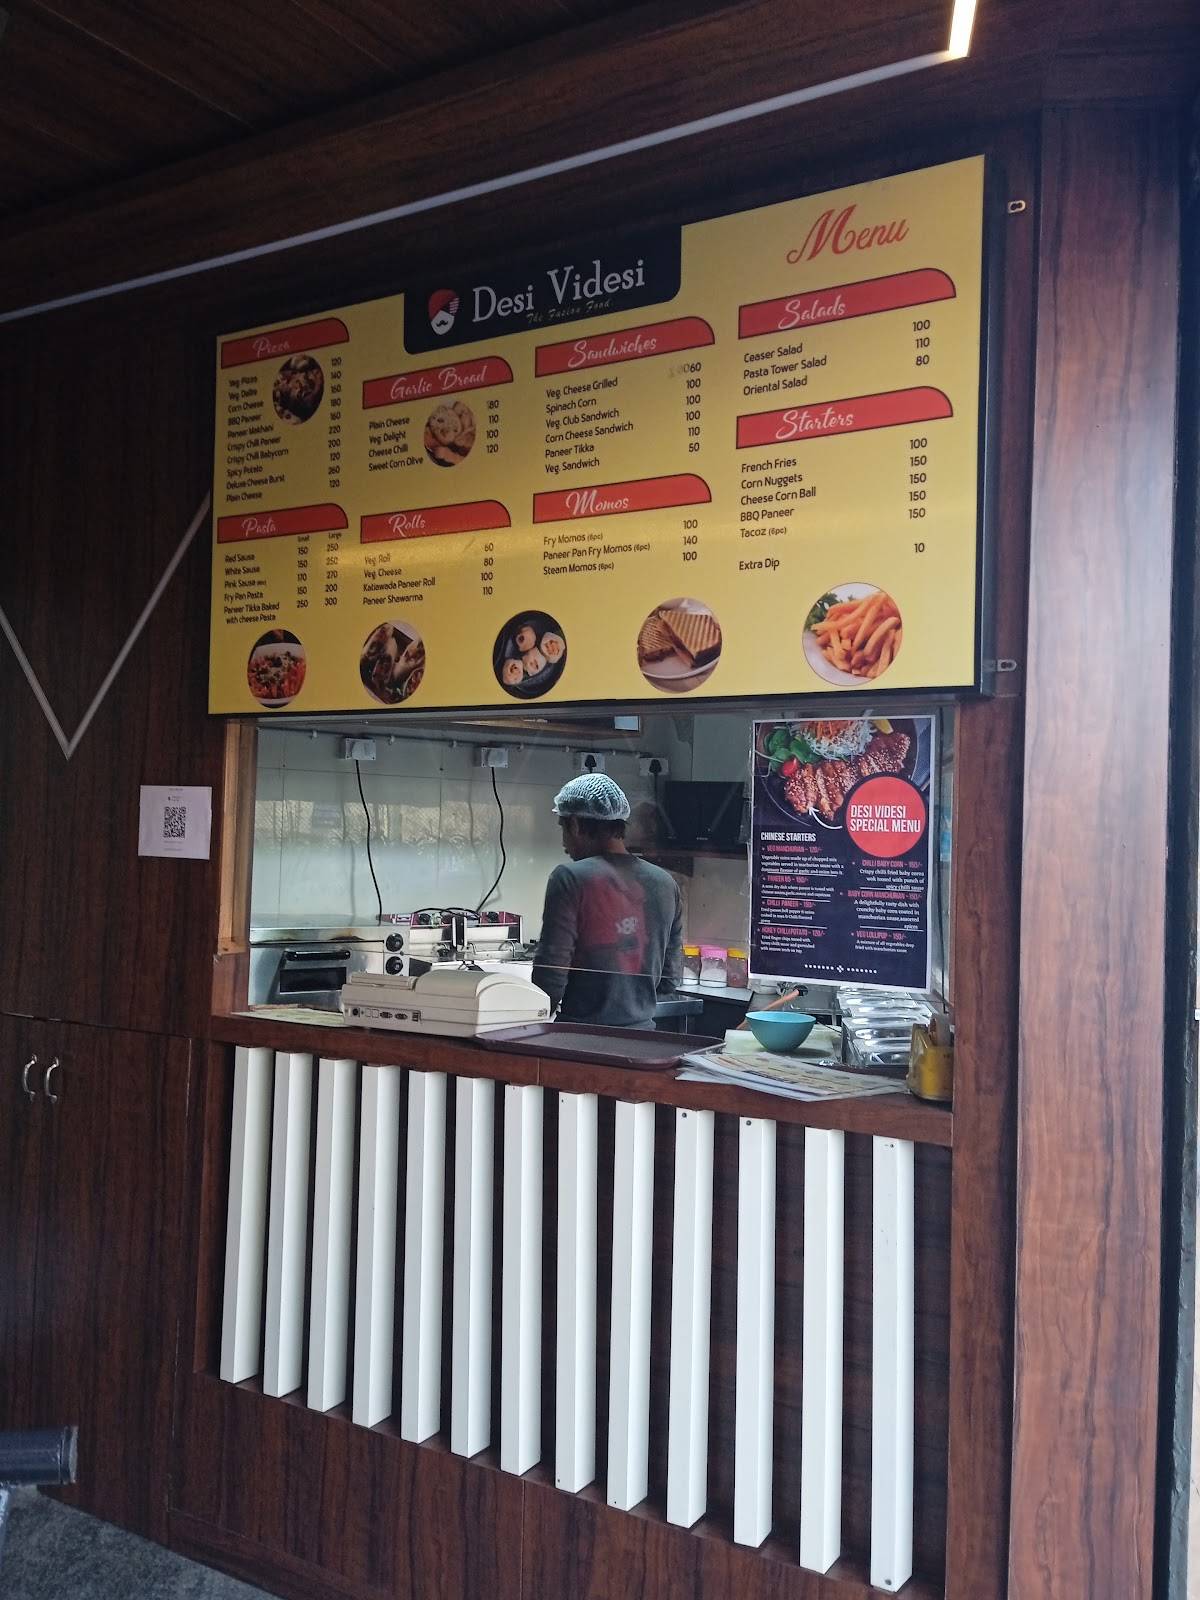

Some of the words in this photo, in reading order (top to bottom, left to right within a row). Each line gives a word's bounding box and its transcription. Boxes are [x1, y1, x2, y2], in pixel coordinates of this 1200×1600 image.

[786, 204, 909, 264] Menu
[472, 284, 535, 323] Desi
[547, 259, 645, 305] Videsi
[778, 295, 845, 329] Salads
[913, 319, 931, 332] 100
[916, 337, 930, 348] 110
[568, 335, 657, 368] Sandwiches
[744, 351, 774, 363] Ceaser
[777, 343, 803, 357] Salad
[916, 355, 929, 366] 80
[744, 368, 768, 379] Pasta
[771, 362, 799, 374] Tower
[801, 355, 827, 368] Salad
[390, 377, 432, 400] Garlic
[439, 365, 488, 390] Bread
[563, 384, 591, 395] Cheese
[593, 377, 618, 389] Grilled
[687, 379, 700, 388] 100
[744, 380, 780, 395] Oriental
[782, 376, 807, 389] Salad
[686, 395, 700, 405] 100
[546, 401, 576, 414] Spinach
[578, 398, 597, 407] Corn
[489, 415, 498, 423] 110
[563, 416, 580, 426] Club
[581, 408, 619, 423] Sandwich
[686, 411, 700, 420] 100
[369, 419, 385, 430] Plain
[386, 417, 410, 426] Cheese
[776, 407, 854, 440] Starters
[383, 431, 406, 441] Delight
[487, 430, 498, 438] 100
[546, 435, 563, 444] Corn
[565, 430, 592, 440] Cheese
[595, 422, 634, 436] Sandwich
[688, 427, 700, 436] 110
[487, 445, 498, 453] 120
[689, 443, 699, 452] 50
[910, 438, 927, 449] 100
[369, 448, 392, 457] Cheese
[545, 448, 572, 458] Paneer
[575, 444, 594, 454] Tikka
[369, 462, 388, 471] Sweet
[390, 460, 405, 469] Corn
[407, 457, 423, 465] Olive
[562, 458, 600, 471] Sandwich
[742, 460, 772, 473] French
[775, 457, 797, 469] Fries
[910, 455, 927, 467] 150
[227, 469, 242, 478] Spicy
[910, 473, 927, 484] 150
[741, 479, 762, 489] Corn
[765, 473, 803, 487] Nuggets
[741, 493, 773, 505] Cheese
[776, 491, 797, 501] Corn
[799, 487, 816, 498] Ball
[909, 490, 926, 501] 150
[566, 490, 629, 515] Momos
[740, 512, 759, 522] BBQ
[761, 507, 795, 519] Paneer
[909, 508, 926, 519] 150
[389, 513, 426, 537] Rolls
[683, 520, 698, 529] 100
[740, 528, 766, 538] Tacoz
[768, 527, 787, 536] (6pc)
[544, 536, 555, 548] Fry
[558, 533, 586, 543] Momos
[683, 536, 697, 545] 140
[327, 543, 338, 551] 250
[485, 543, 493, 551] 60
[543, 550, 570, 560] Paneer
[572, 548, 587, 557] Pan
[589, 547, 601, 558] Fry
[603, 543, 632, 553] Momos
[914, 543, 925, 553] 10
[484, 558, 493, 566] 80
[683, 552, 697, 561] 100
[543, 565, 567, 575] Steam
[569, 562, 597, 572] Momos
[739, 560, 763, 570] Extra
[765, 558, 780, 570] Dip
[379, 568, 402, 576] Cheese
[481, 572, 493, 580] 100
[326, 584, 337, 592] 200
[398, 579, 421, 588] Paneer
[423, 577, 436, 586] Roll
[483, 587, 492, 595] 110
[224, 594, 233, 603] Fry
[325, 598, 337, 606] 300
[363, 596, 386, 605] Paneer
[388, 593, 423, 604] Shawarma
[262, 602, 280, 610] Baked
[226, 616, 238, 624] with
[851, 805, 872, 818] DESI
[875, 806, 906, 818] VIDESI
[851, 819, 889, 832] SPECIAL
[891, 820, 921, 832] MENU
[761, 832, 785, 841] CHINESE
[786, 832, 816, 842] STARTERS
